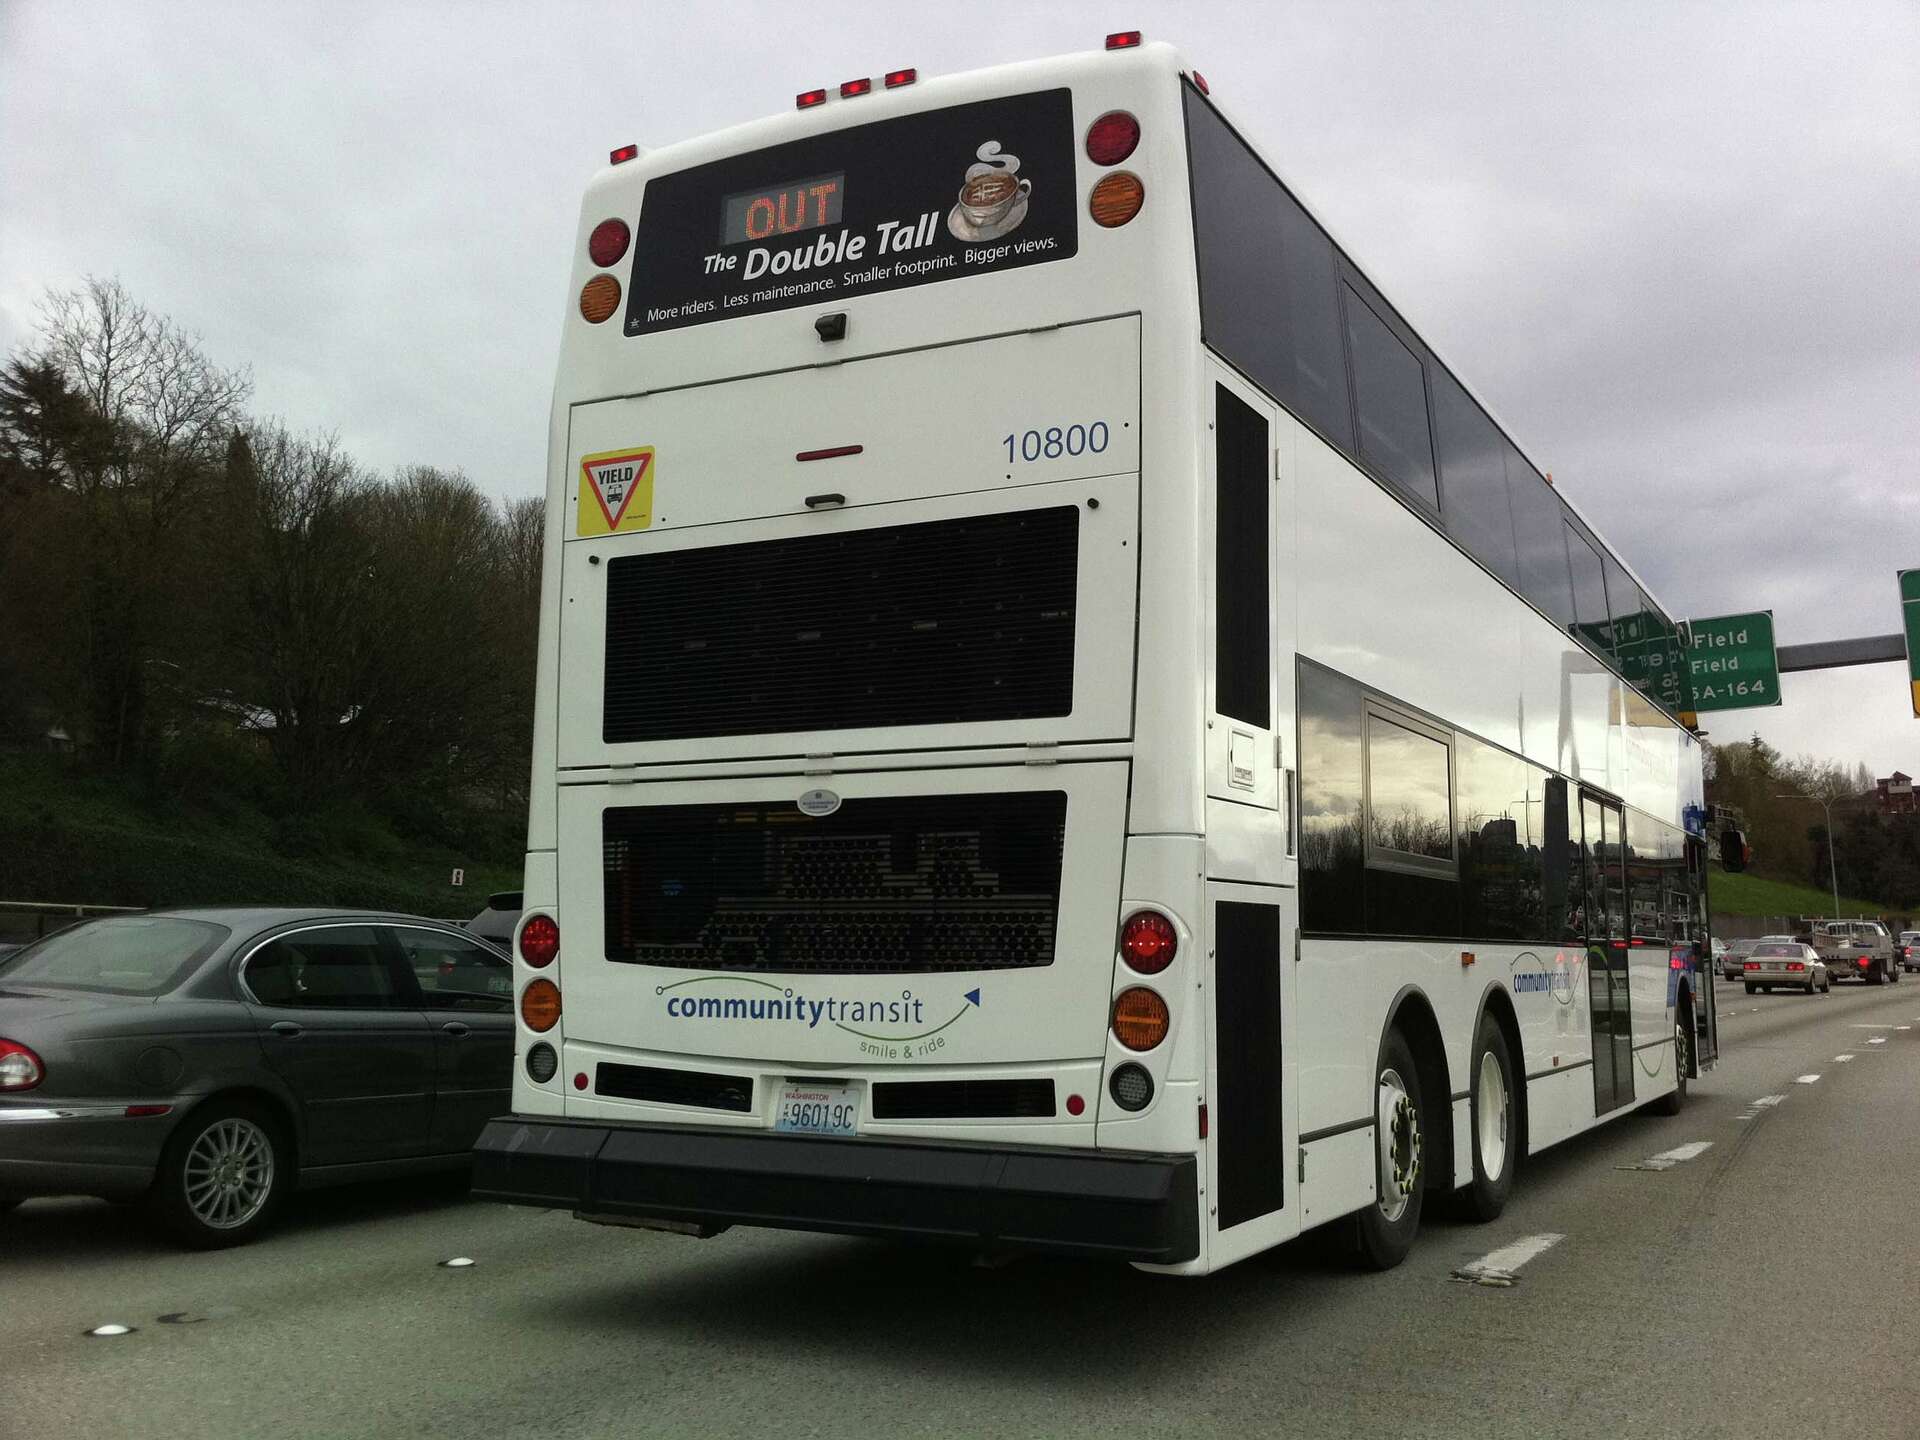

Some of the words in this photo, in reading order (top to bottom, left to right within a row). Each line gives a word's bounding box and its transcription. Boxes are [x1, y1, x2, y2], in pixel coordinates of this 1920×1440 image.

[745, 182, 836, 240] OUT
[704, 253, 737, 274] The
[743, 229, 866, 280] Double
[876, 211, 940, 255] Tall
[647, 304, 678, 322] More
[681, 299, 718, 316] riders.
[724, 292, 749, 308] Less
[752, 278, 837, 302] maintenance.
[843, 265, 892, 286] Smaller
[894, 254, 958, 277] footprint.
[965, 245, 1011, 265] Bigger
[1014, 237, 1058, 255] views.
[1003, 421, 1109, 464] 10800
[598, 467, 633, 485] YIELD
[1693, 629, 1748, 649] Field
[1691, 656, 1738, 675] Field
[860, 1041, 897, 1059] smile
[903, 1045, 913, 1059] &
[918, 1037, 945, 1056] ride
[784, 1092, 830, 1101] WASHINGTON
[790, 1103, 854, 1129] 96019C
